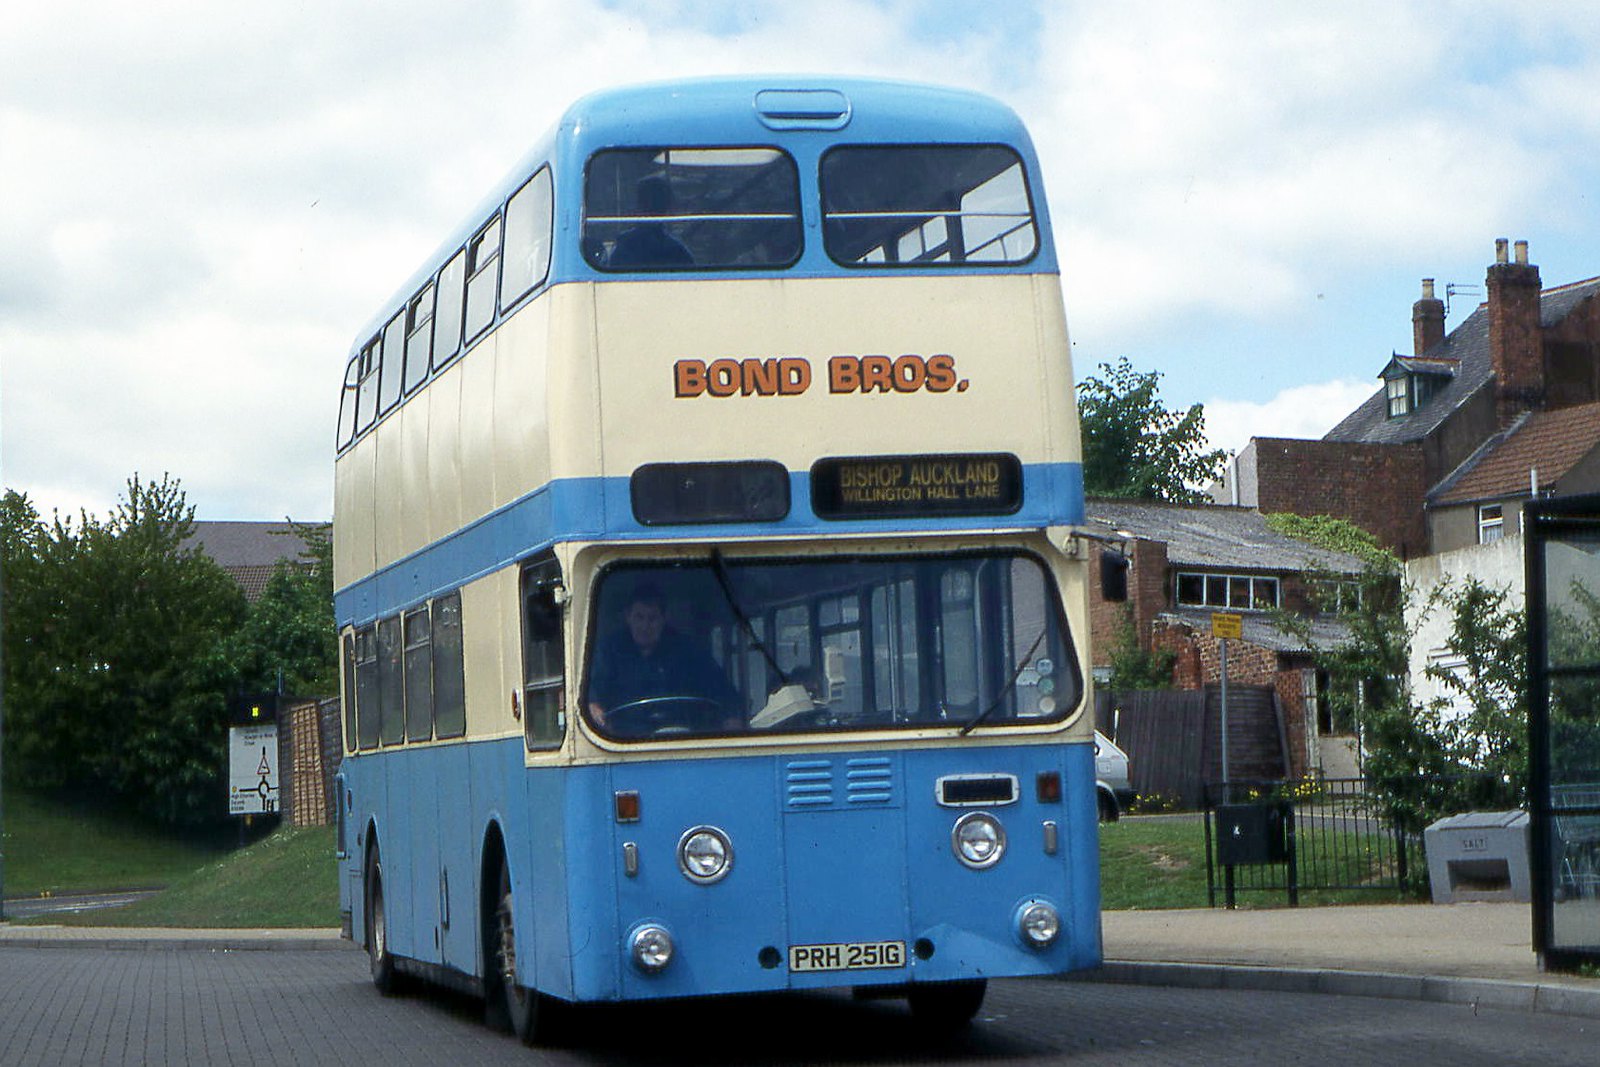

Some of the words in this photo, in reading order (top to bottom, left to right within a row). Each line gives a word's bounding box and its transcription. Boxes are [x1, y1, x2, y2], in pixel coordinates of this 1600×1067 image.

[674, 358, 811, 398] BOND
[828, 354, 970, 396] BROS.
[841, 464, 902, 487] BISHOP
[910, 461, 999, 485] AUCKLAND
[842, 487, 921, 502] WILLINGTON
[927, 485, 960, 499] HALL
[965, 484, 999, 498] LANE
[1463, 838, 1484, 849] SALT
[795, 947, 840, 968] PRH
[847, 944, 900, 966] 251G
